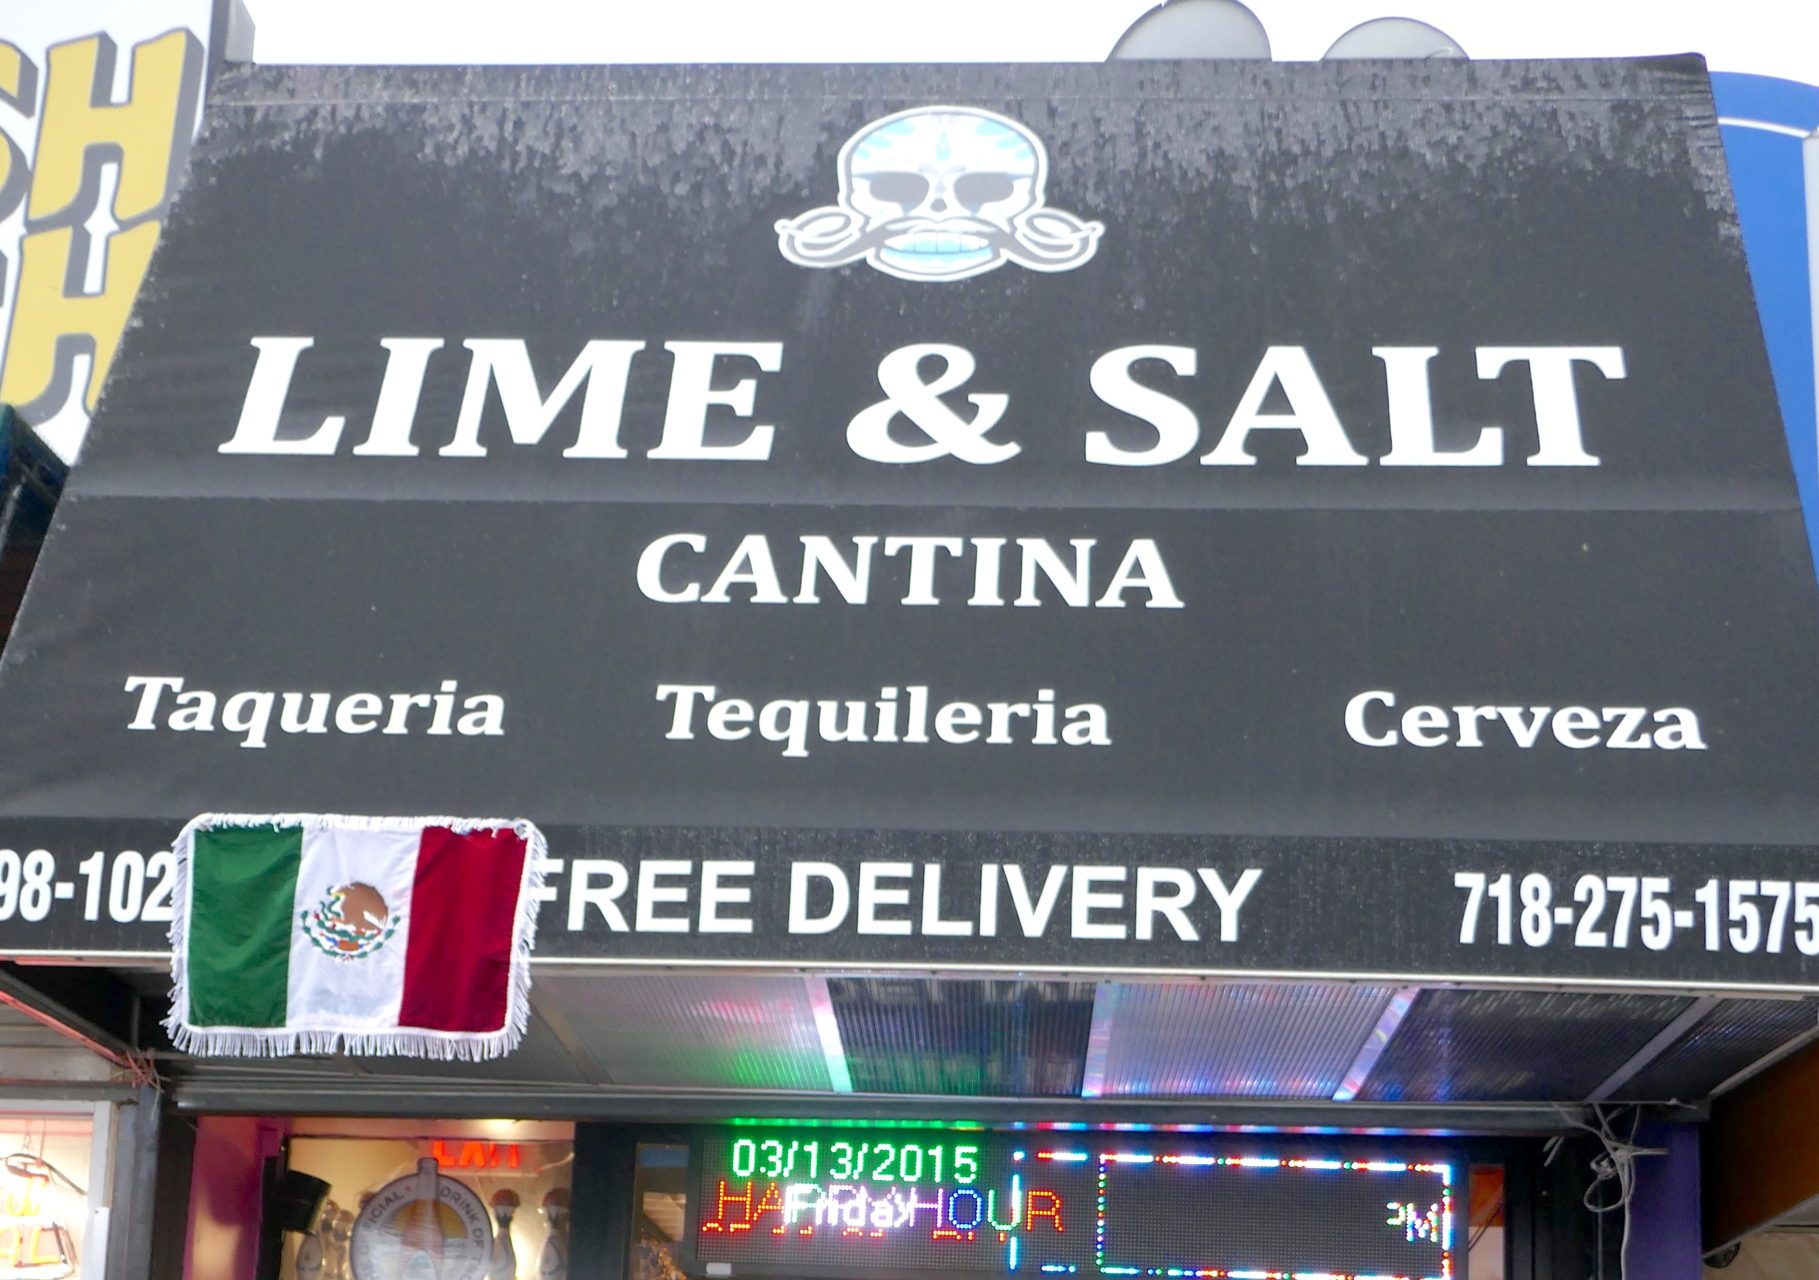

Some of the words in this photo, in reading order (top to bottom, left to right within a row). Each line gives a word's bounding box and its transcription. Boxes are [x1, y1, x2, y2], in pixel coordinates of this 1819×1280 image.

[217, 336, 784, 462] LIME
[845, 342, 1022, 465] &
[1084, 343, 1628, 467] SALT
[635, 532, 1185, 609] CANTINA
[123, 675, 505, 749] Taqueria
[655, 683, 1113, 758] Tequileria
[1343, 689, 1708, 751] Cerveza
[787, 860, 1263, 943] DELIVERY
[1453, 871, 1819, 956] 718-275-1575
[732, 1138, 978, 1184] 03/13/2015
[359, 1190, 405, 1256] OICIAL
[439, 1185, 481, 1225] DRINK
